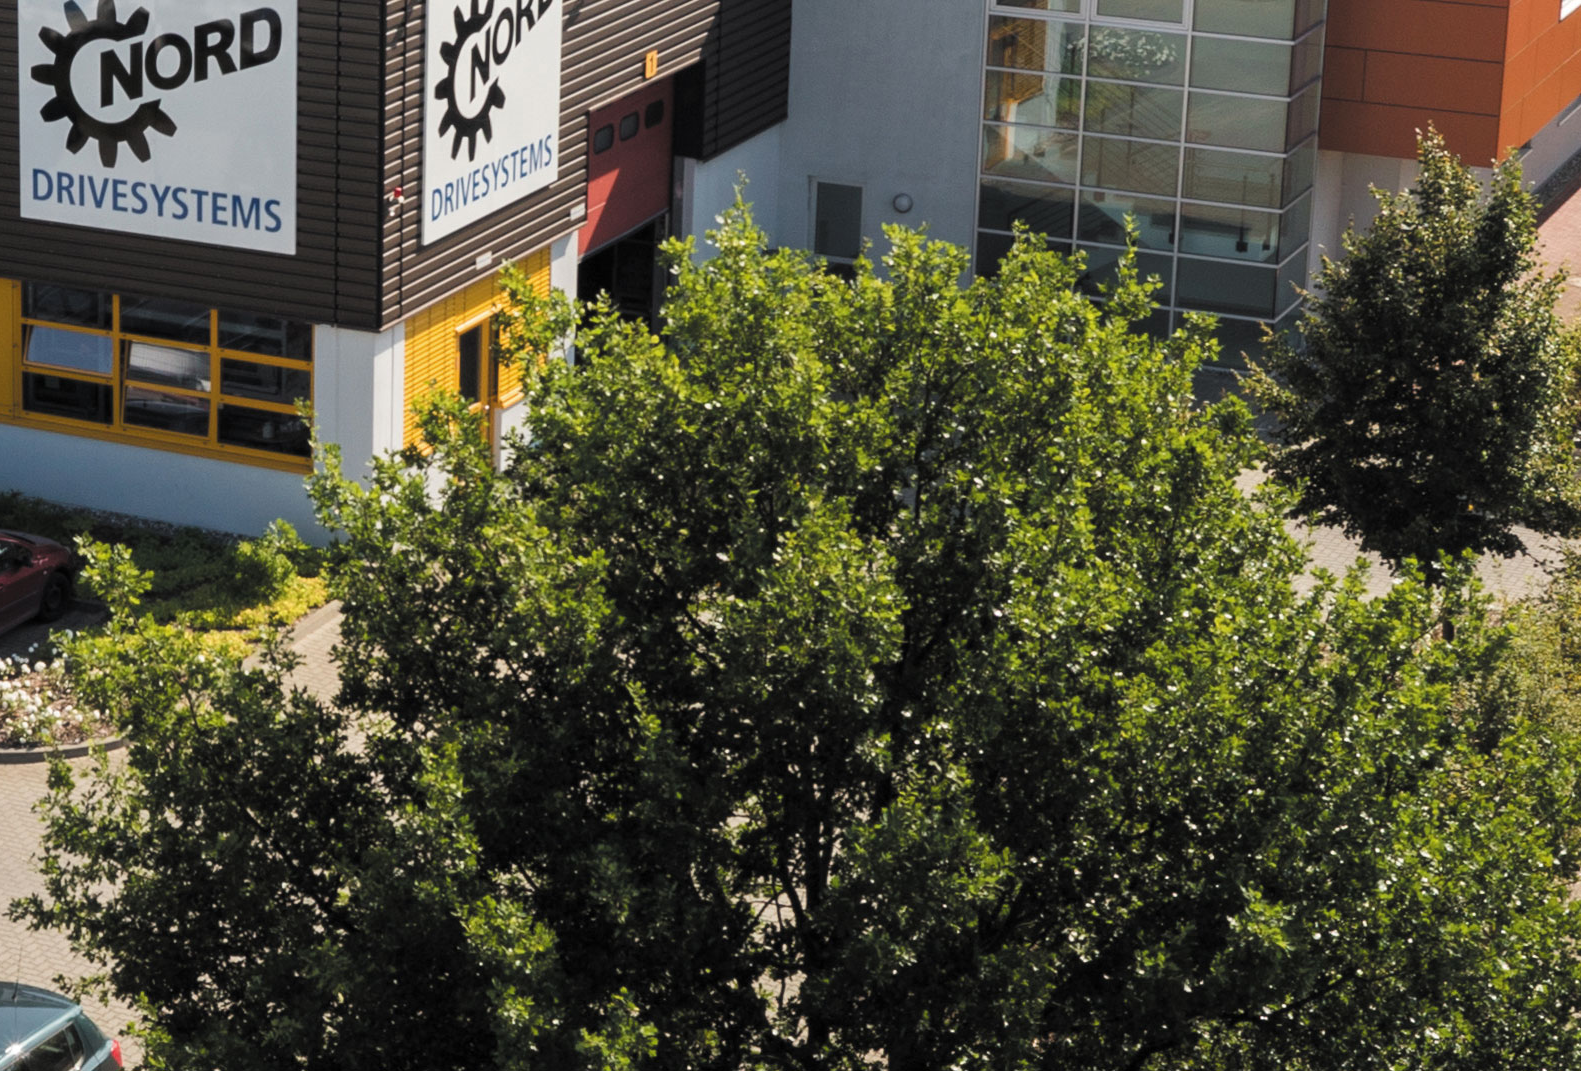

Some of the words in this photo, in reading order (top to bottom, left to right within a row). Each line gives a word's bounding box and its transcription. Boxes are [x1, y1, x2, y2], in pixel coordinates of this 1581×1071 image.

[100, 6, 283, 109] NORD
[31, 168, 283, 233] DRIVESYSTEMS
[431, 134, 553, 222] DRIVESYSTEMS
